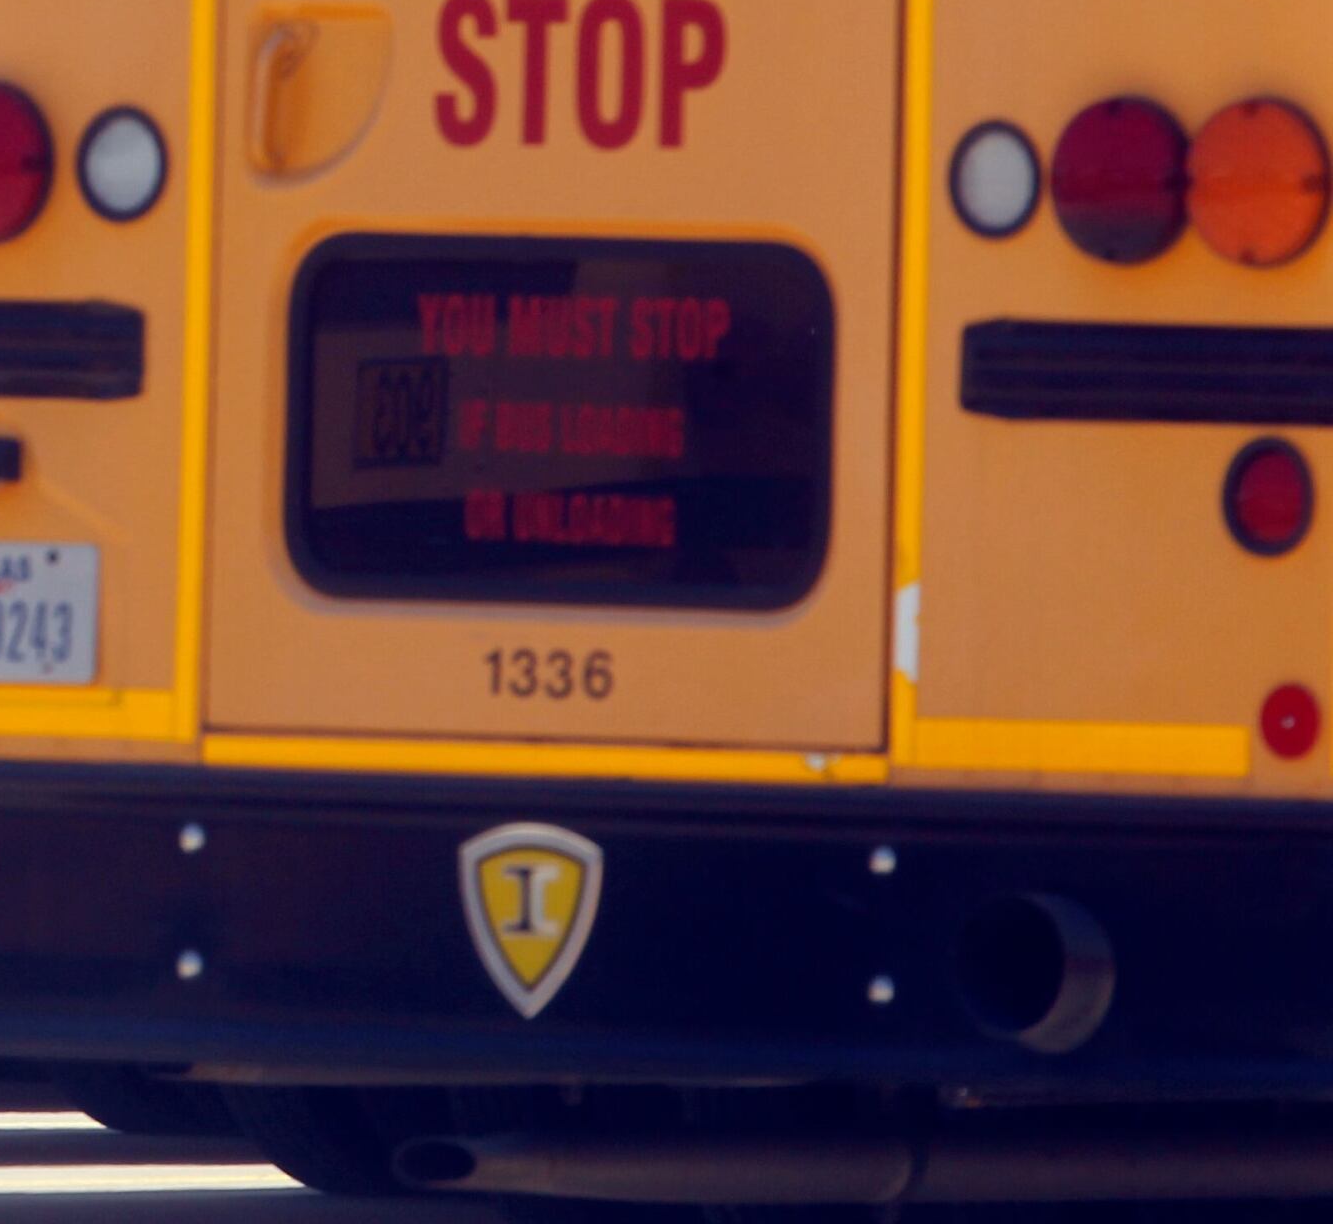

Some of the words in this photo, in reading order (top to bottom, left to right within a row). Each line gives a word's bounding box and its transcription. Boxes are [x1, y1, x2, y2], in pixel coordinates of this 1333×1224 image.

[417, 292, 496, 357] YOU
[507, 293, 618, 358] MUST
[632, 296, 732, 361] STOP
[484, 647, 613, 701] 1336
